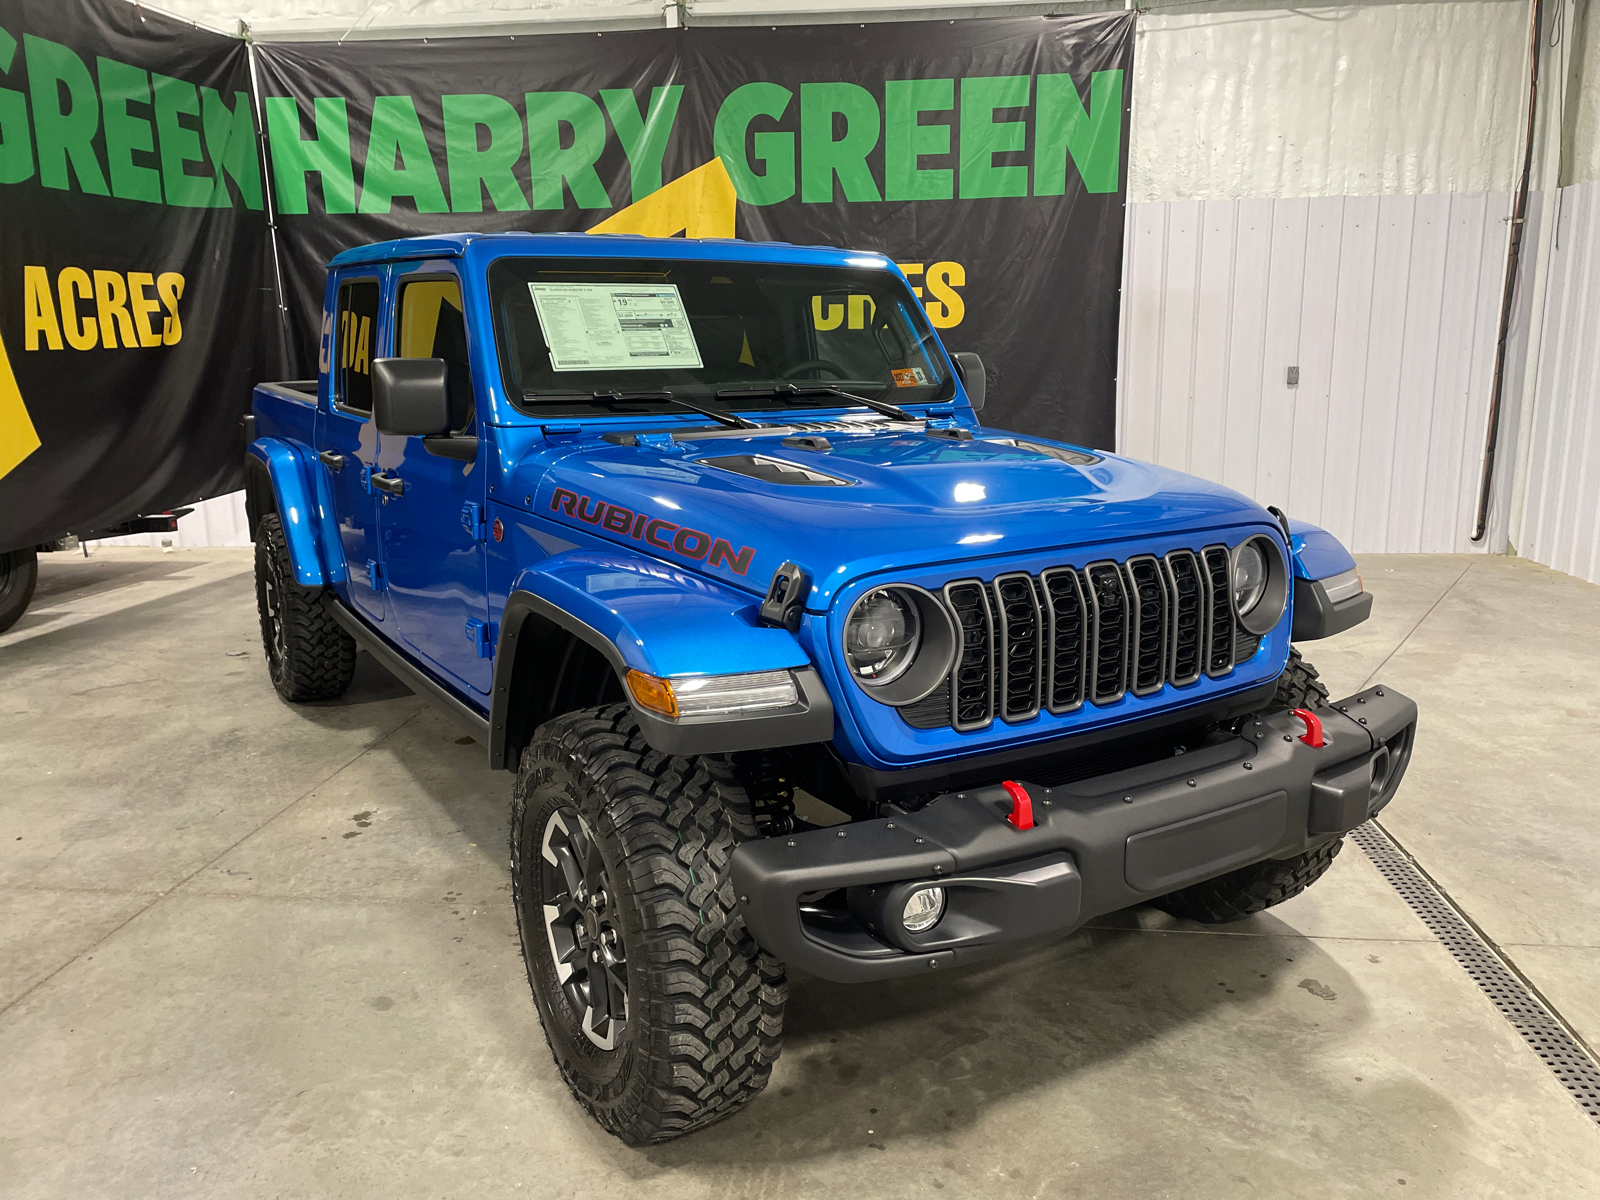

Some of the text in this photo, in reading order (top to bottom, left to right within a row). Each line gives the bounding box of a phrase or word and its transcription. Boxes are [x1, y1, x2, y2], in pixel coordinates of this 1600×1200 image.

[265, 69, 1123, 214] HARRY GREEN
[24, 265, 186, 351] ACRES
[617, 298, 628, 306] 19
[550, 487, 757, 576] RUBICON
